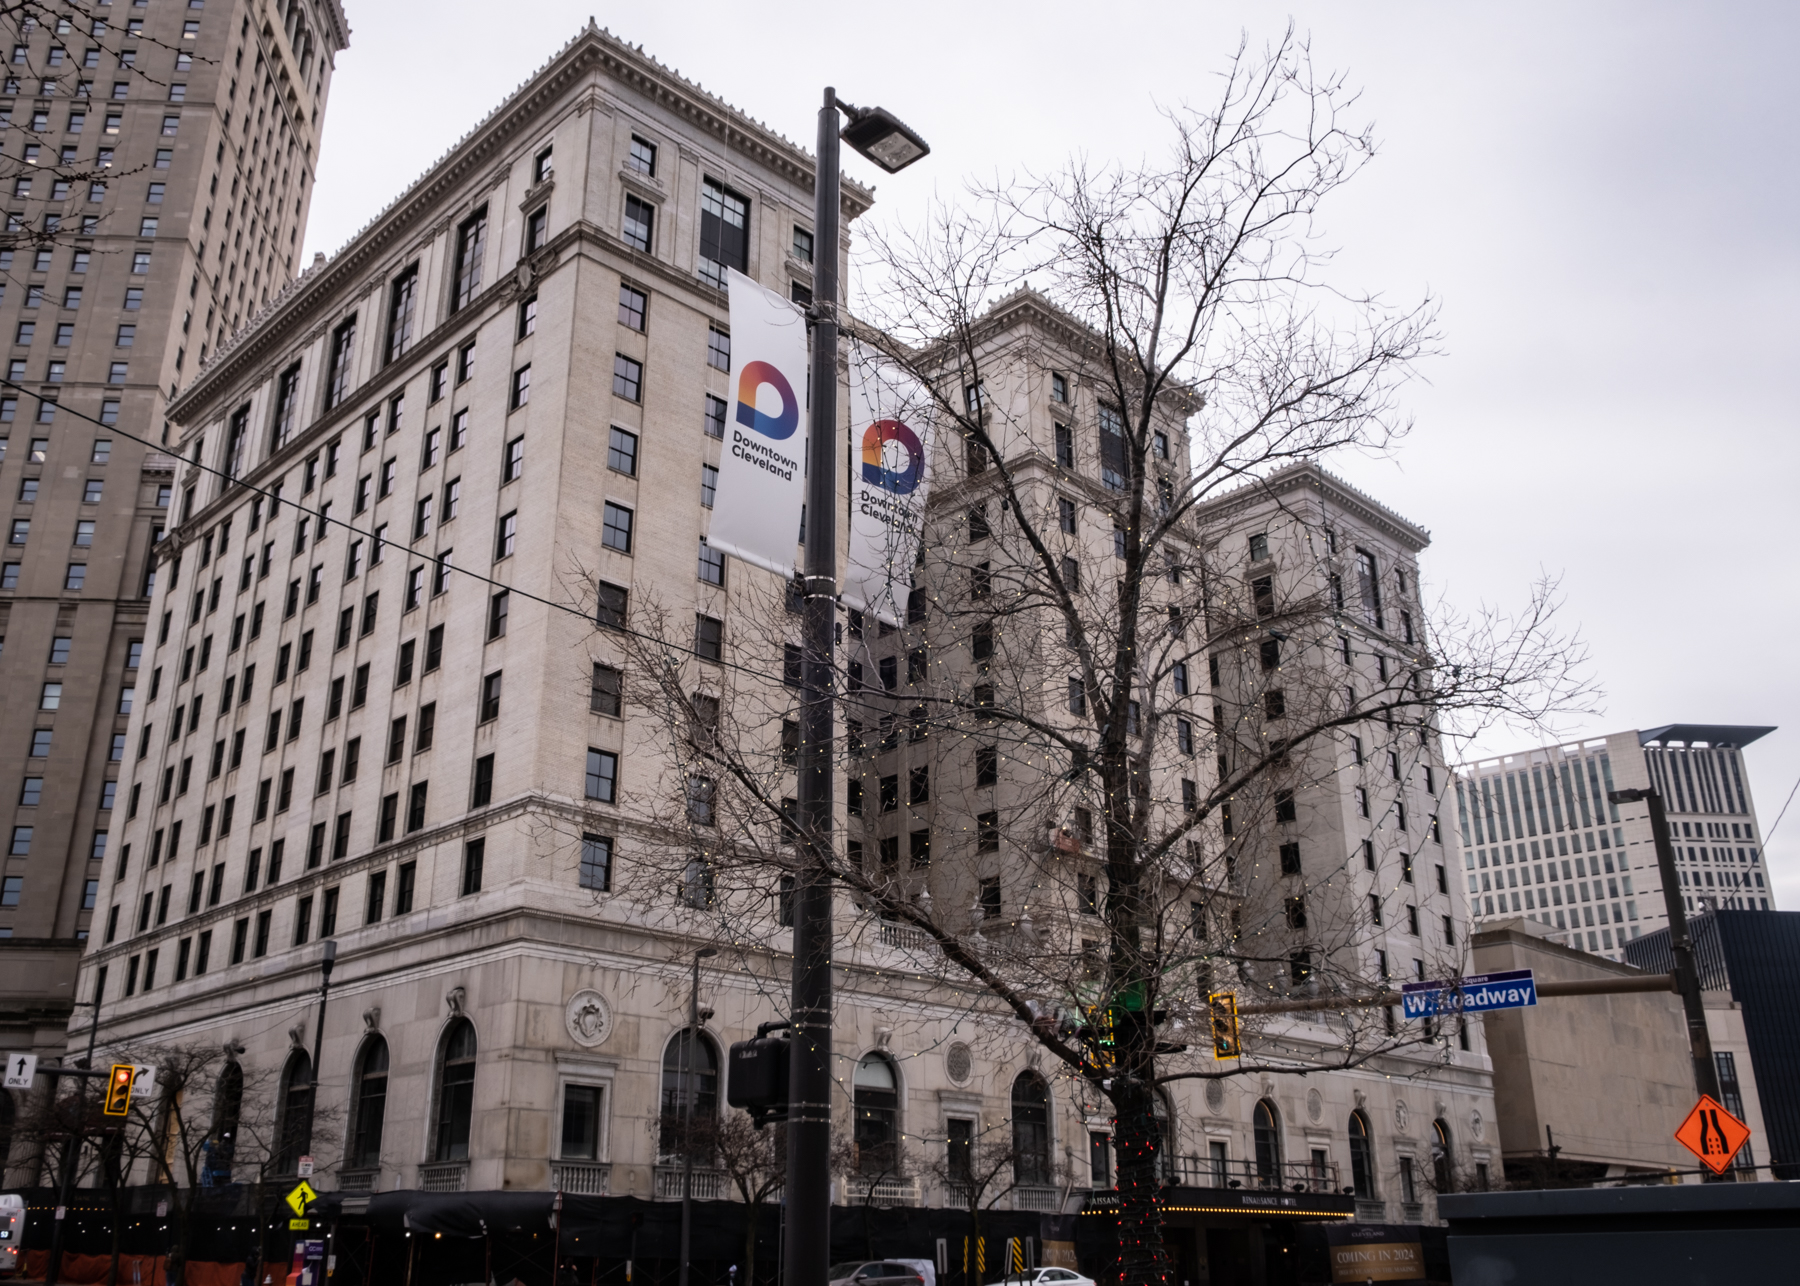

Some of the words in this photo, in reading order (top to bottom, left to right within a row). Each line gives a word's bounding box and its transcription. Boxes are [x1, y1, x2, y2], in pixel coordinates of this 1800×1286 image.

[732, 444, 792, 481] Cleveland
[733, 430, 797, 471] Downtown
[861, 490, 918, 523] Downtown
[861, 503, 914, 534] Cleveland
[1463, 975, 1489, 985] Square
[1406, 995, 1432, 1014] W.
[8, 1077, 28, 1085] ONLY
[1337, 1250, 1376, 1264] COMING
[1379, 1249, 1391, 1261] IN
[1394, 1248, 1414, 1260] 2024
